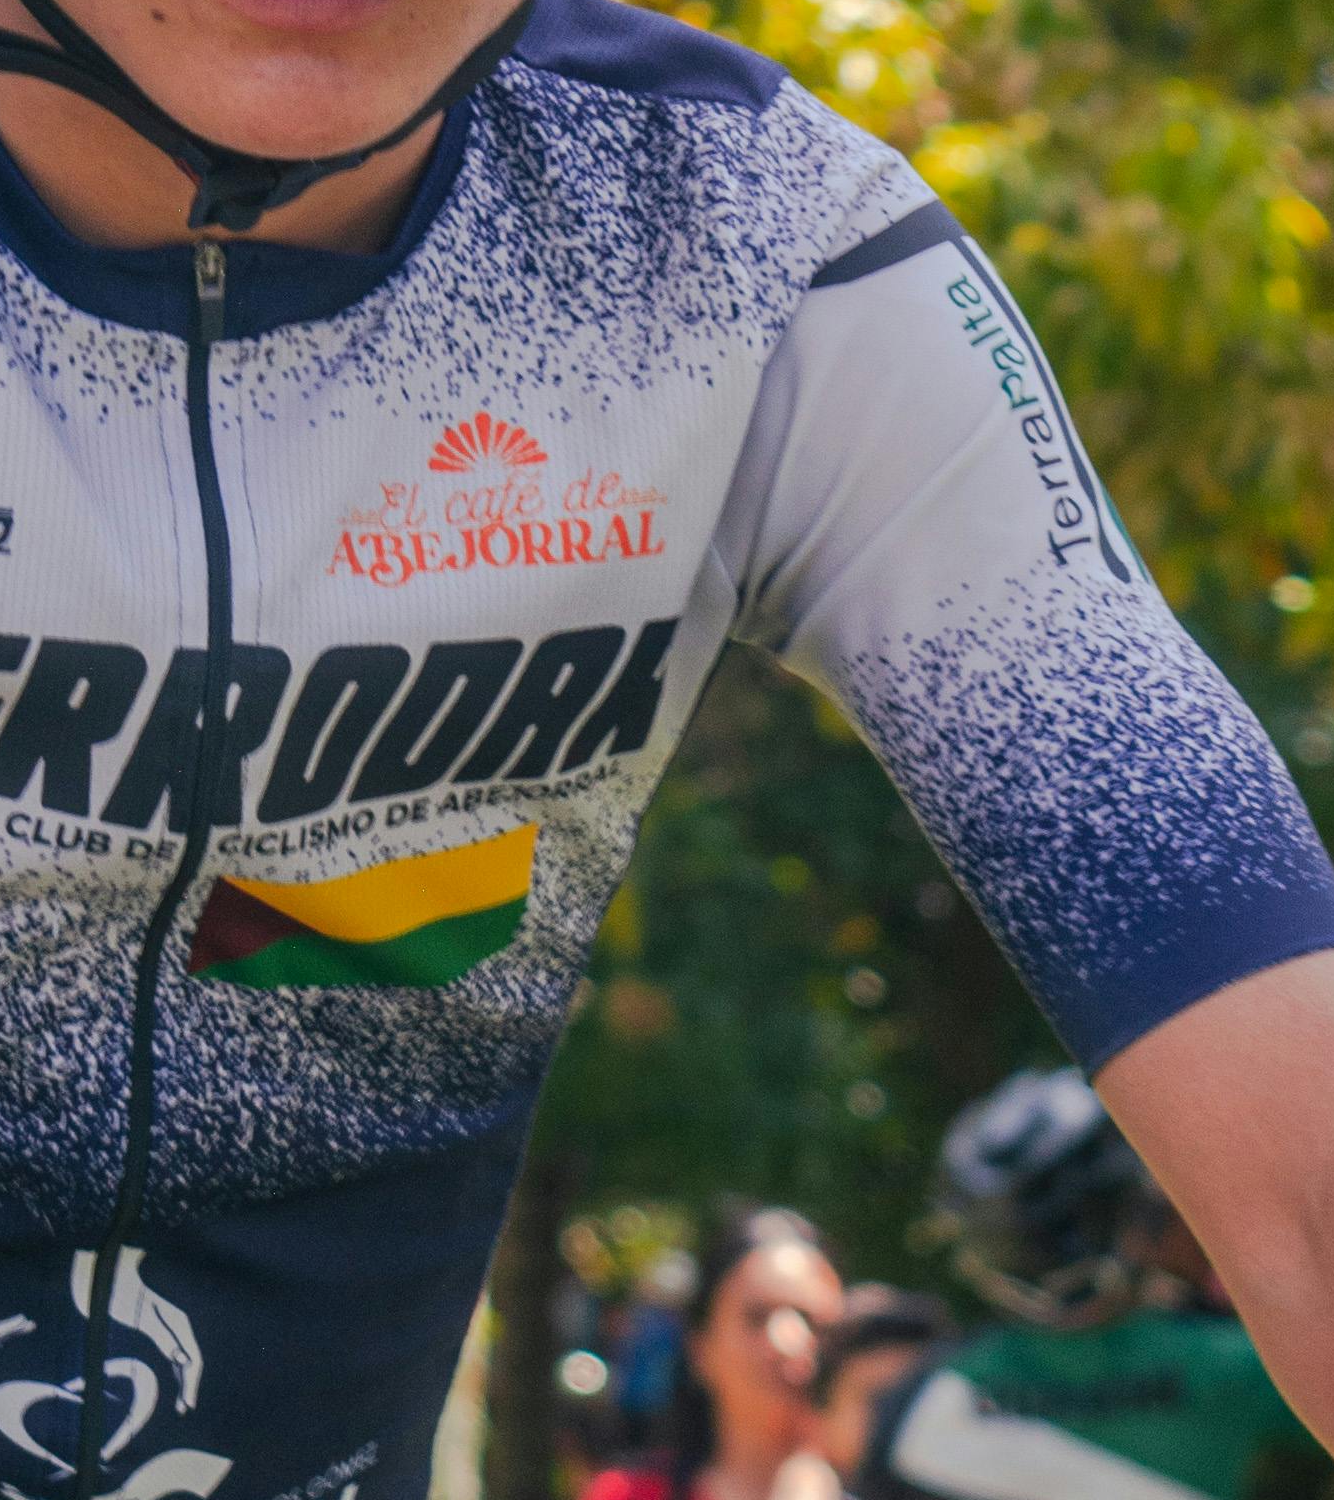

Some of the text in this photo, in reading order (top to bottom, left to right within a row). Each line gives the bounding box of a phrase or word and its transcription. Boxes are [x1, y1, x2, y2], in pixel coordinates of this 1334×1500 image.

[326, 509, 667, 589] ABEJORRAL
[5, 811, 112, 857] CLUB
[218, 807, 376, 858] CICLISMO
[385, 797, 436, 828] DE
